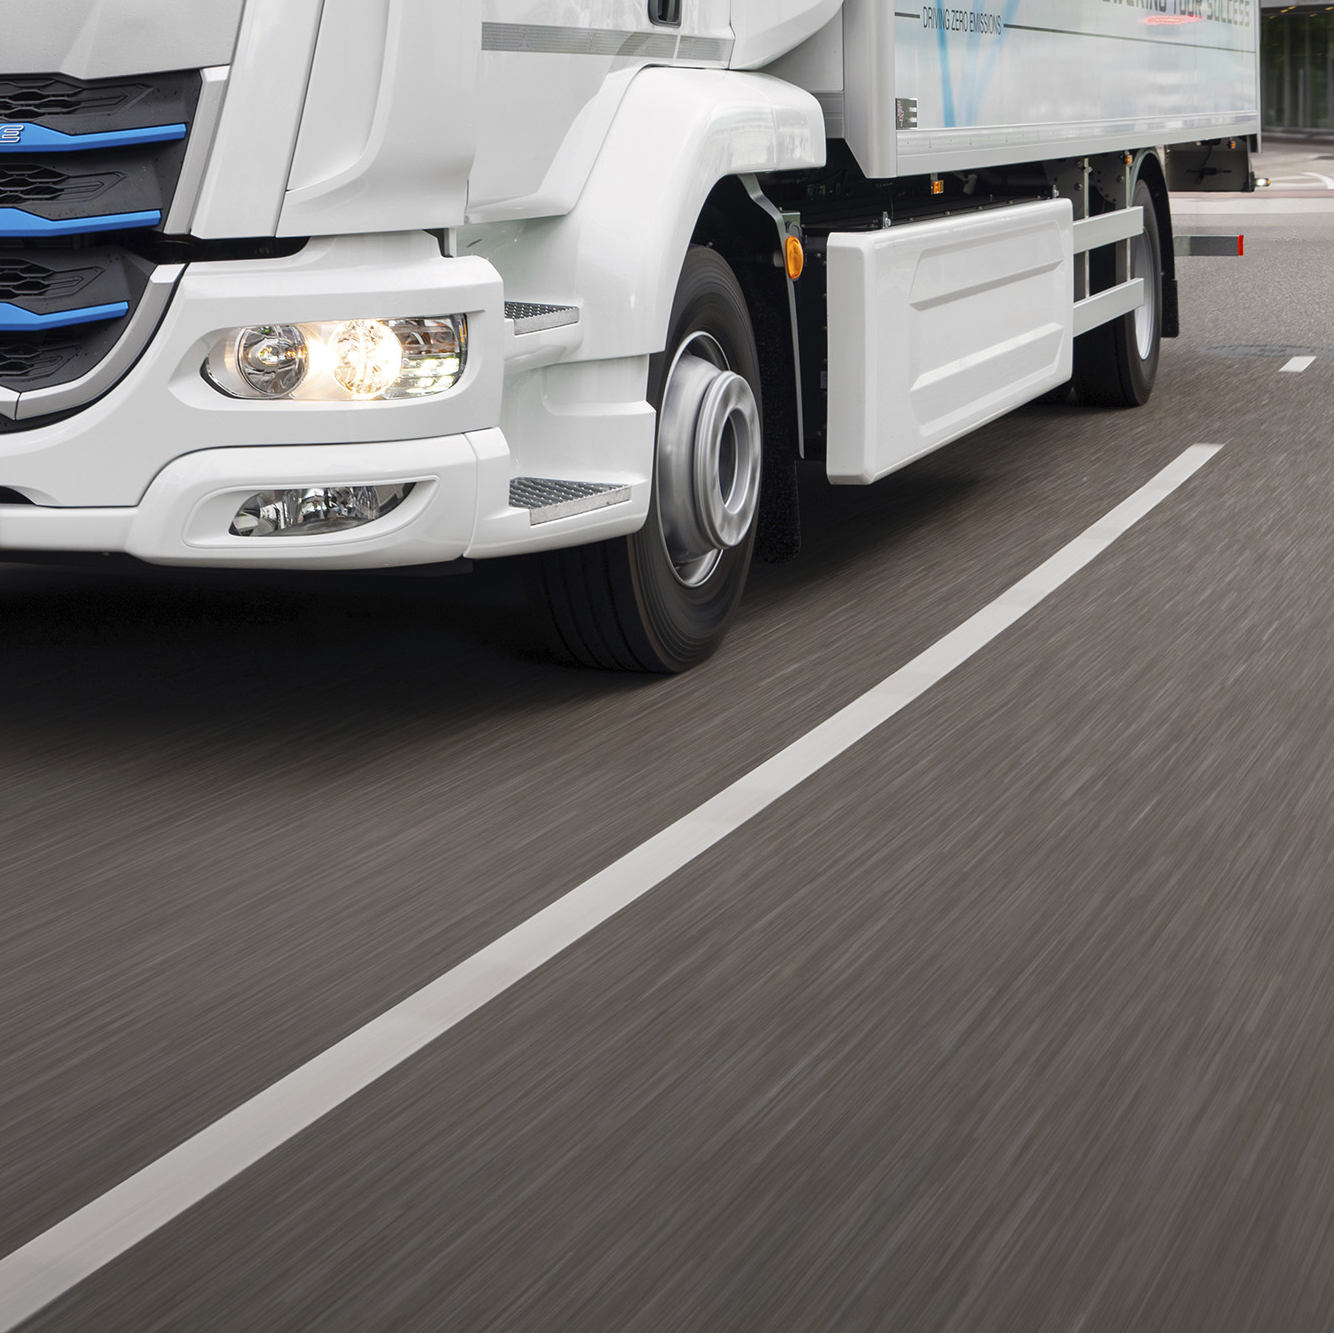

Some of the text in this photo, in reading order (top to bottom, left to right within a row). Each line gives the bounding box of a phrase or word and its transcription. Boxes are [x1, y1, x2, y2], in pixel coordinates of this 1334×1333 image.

[923, 6, 1002, 35] DRIVING ZERO EMISSIONS
